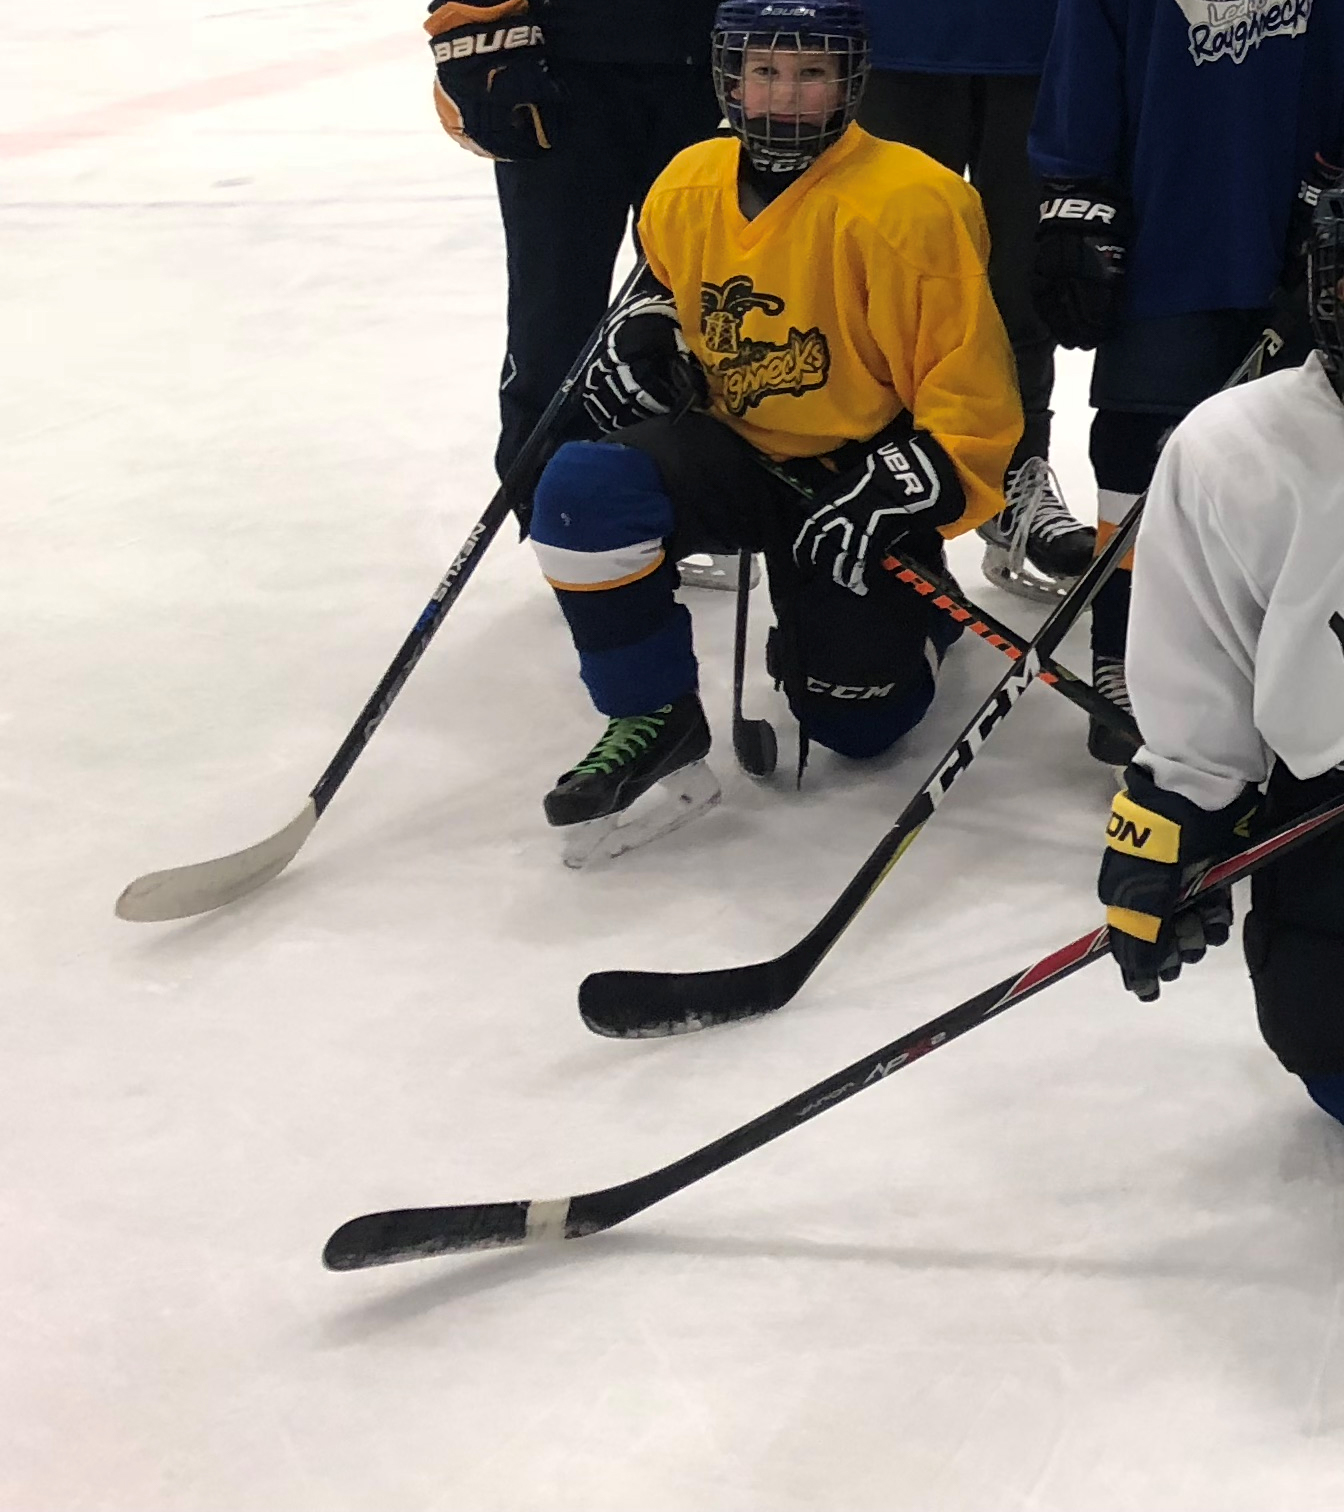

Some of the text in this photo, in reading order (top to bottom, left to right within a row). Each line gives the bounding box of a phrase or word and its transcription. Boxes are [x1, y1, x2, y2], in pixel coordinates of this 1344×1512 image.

[761, 7, 817, 18] BAUER
[435, 26, 545, 64] BAUER
[807, 680, 894, 700] CCM
[924, 657, 1041, 813] CCM
